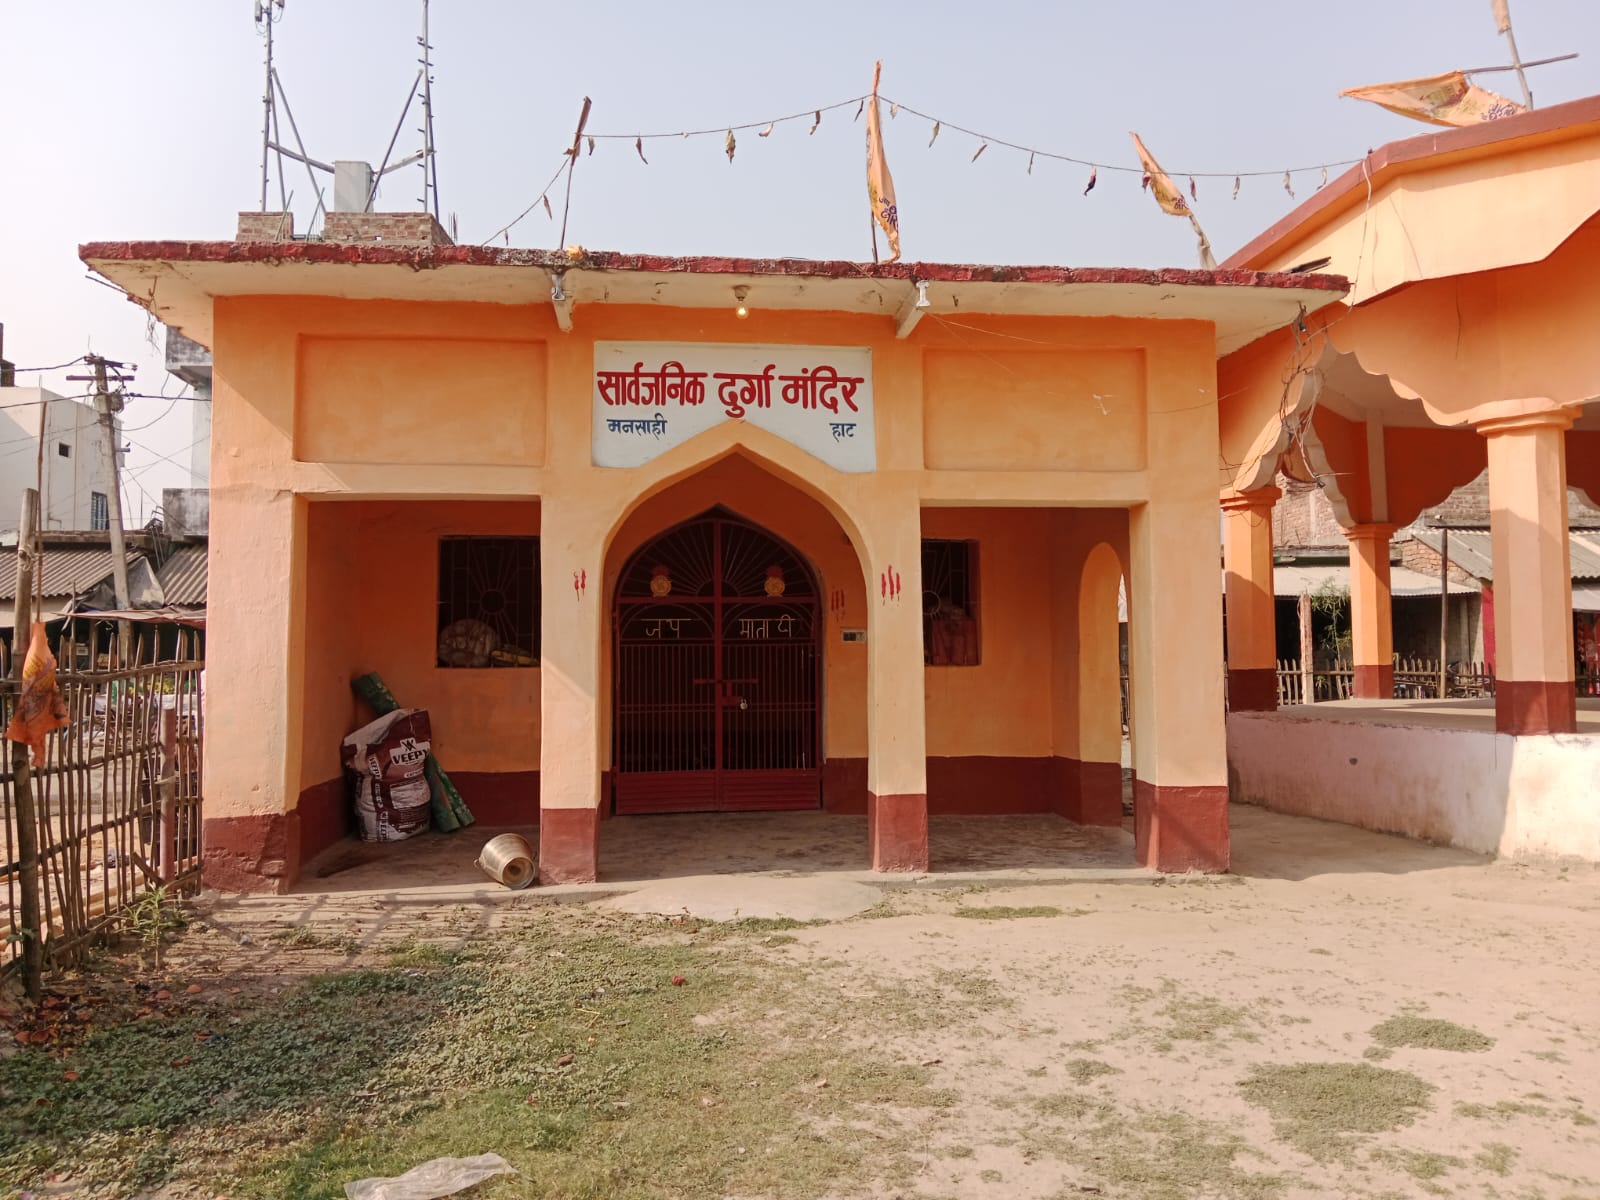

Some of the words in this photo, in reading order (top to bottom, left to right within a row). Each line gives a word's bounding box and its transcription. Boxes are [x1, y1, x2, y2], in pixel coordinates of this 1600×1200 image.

[597, 361, 708, 406] सार्वजनिक
[713, 364, 776, 418] दुर्गा
[778, 365, 865, 414] मंदिर
[606, 412, 667, 440] मनसाही
[829, 422, 857, 442] हाट
[738, 618, 770, 639] माता
[776, 614, 797, 639] दी
